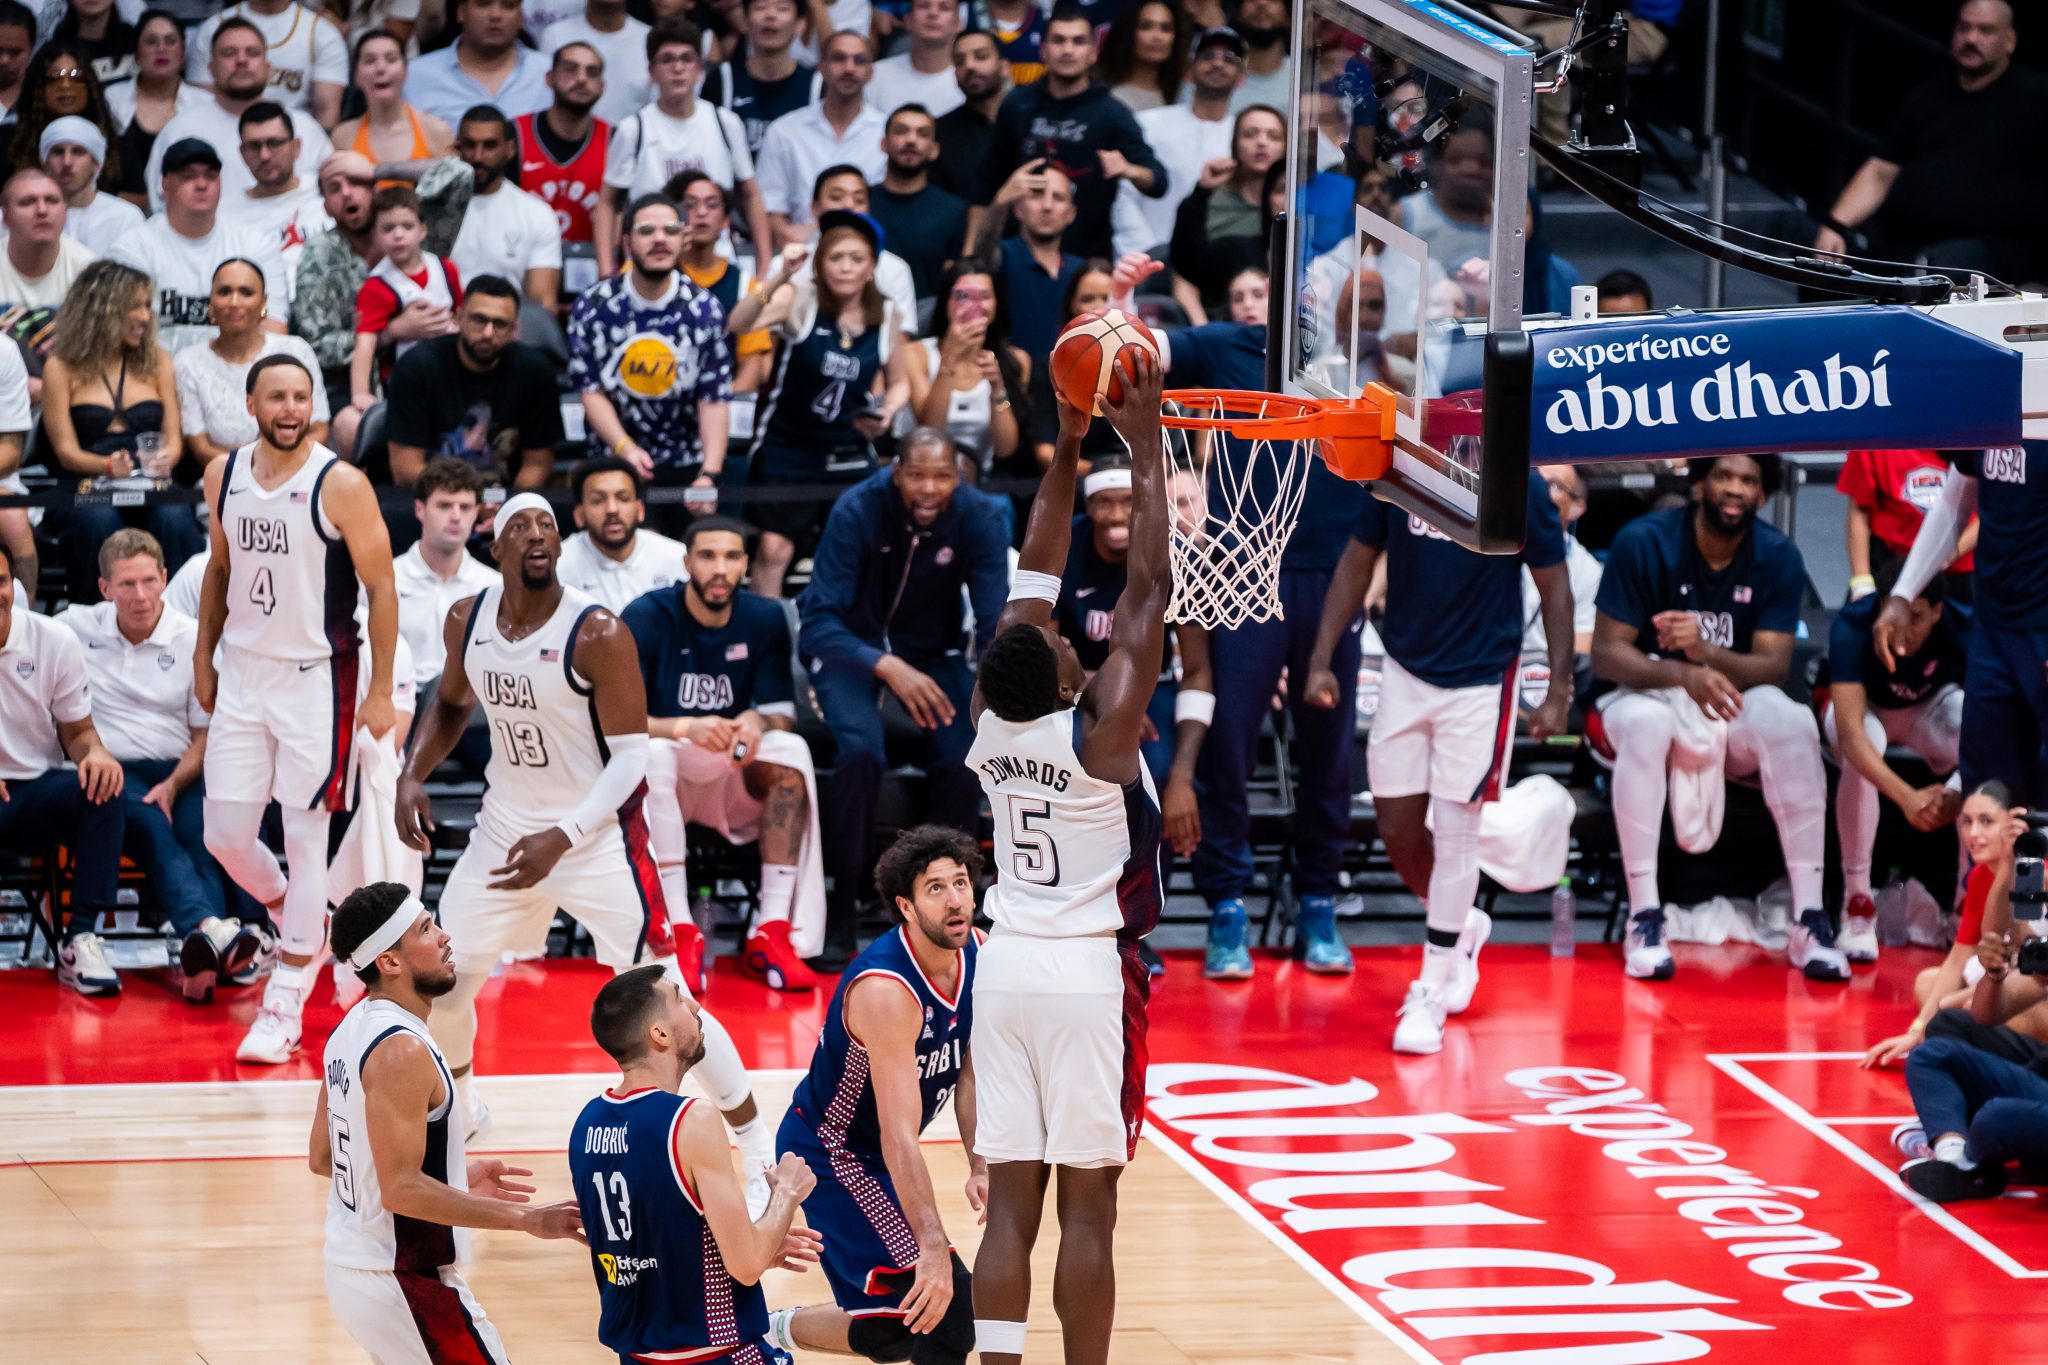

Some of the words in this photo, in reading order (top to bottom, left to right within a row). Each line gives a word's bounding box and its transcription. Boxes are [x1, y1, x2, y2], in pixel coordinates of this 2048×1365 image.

[1547, 333, 1731, 374] experíence
[810, 380, 847, 423] 4
[1545, 372, 1679, 434] abu
[1690, 349, 1892, 422] dhabí
[1983, 447, 2027, 485] USA
[237, 516, 289, 555] USA
[249, 566, 276, 616] 4
[483, 669, 538, 711] USA
[678, 672, 734, 711] USA
[494, 717, 549, 768] 13
[980, 755, 1072, 793] EDWARDS
[1007, 794, 1061, 888] 5
[327, 1058, 350, 1102] BOOKER
[585, 1121, 629, 1154] DOBRIĆ
[1144, 1062, 1548, 1234] abu
[326, 1107, 356, 1213] 5
[592, 1171, 633, 1242] 13
